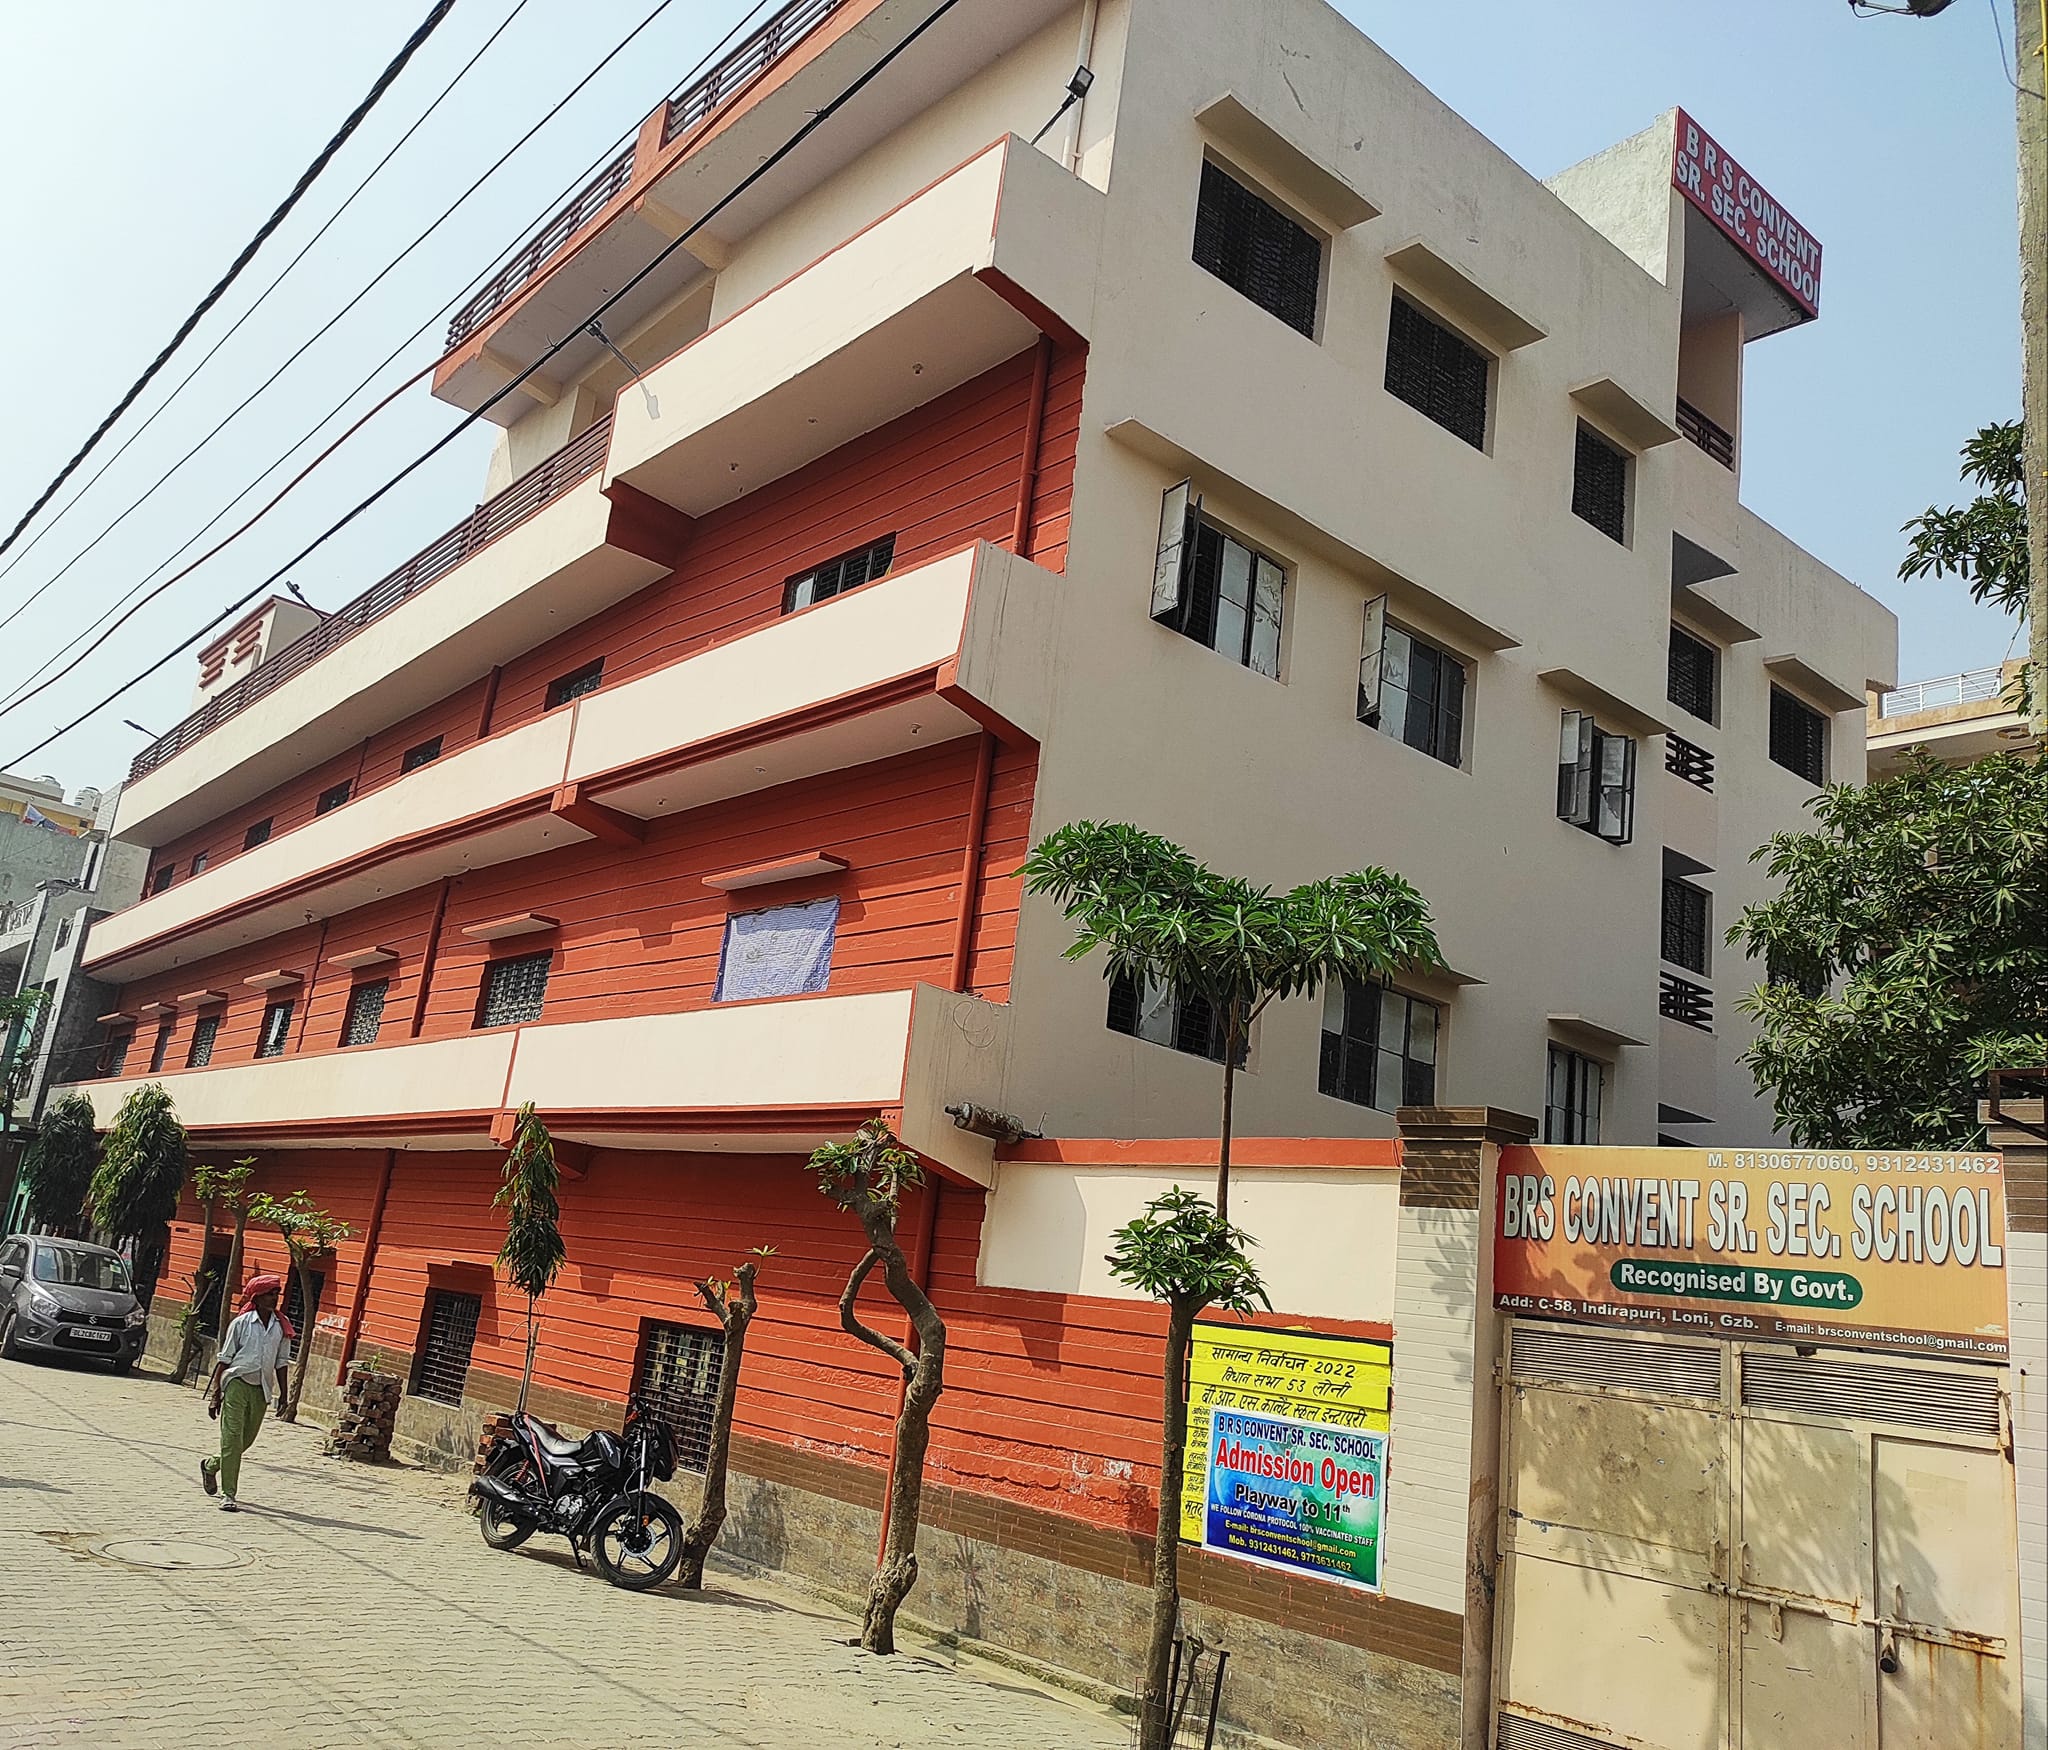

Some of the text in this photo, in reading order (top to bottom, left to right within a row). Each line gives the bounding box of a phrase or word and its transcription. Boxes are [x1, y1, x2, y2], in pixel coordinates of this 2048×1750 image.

[1676, 150, 1705, 202] SR.
[1711, 184, 1751, 244] SEC.
[1686, 123, 1819, 272] B R S CONVENT
[1707, 1153, 2000, 1174] M. 8130677060, 9312431462
[1503, 1174, 2003, 1267] BRS CONVENT SR. SEC. SCHOOL
[1621, 1263, 1854, 1301] Recognised By Govt.
[1500, 1294, 1759, 1330] Add: C-58, Indirapuri, Loni, Gzb.
[1775, 1321, 2007, 1353] E-mail: brsconventschool@gmail.com
[1212, 1347, 1253, 1364] सामान्य
[1257, 1349, 1309, 1371] निर्वाचन
[1222, 1366, 1352, 1398] विधान सभा 53 लोनी
[1219, 1416, 1224, 1431] B
[1228, 1418, 1234, 1433] R
[1236, 1420, 1242, 1434] S
[1244, 1421, 1289, 1443] CONVENT
[1291, 1429, 1306, 1446] SR.
[1309, 1432, 1331, 1450] SEC.
[1334, 1436, 1376, 1459] SCHOOL
[1215, 1438, 1375, 1498] Admission Open
[1236, 1484, 1297, 1516] Playway
[1302, 1500, 1318, 1516] to
[1211, 1503, 1374, 1546] WE FOLLOW CORONA PROTOCOL 100% VACCINATED STAFF
[1225, 1520, 1248, 1532] E-mail:
[1229, 1534, 1247, 1547] Mob.
